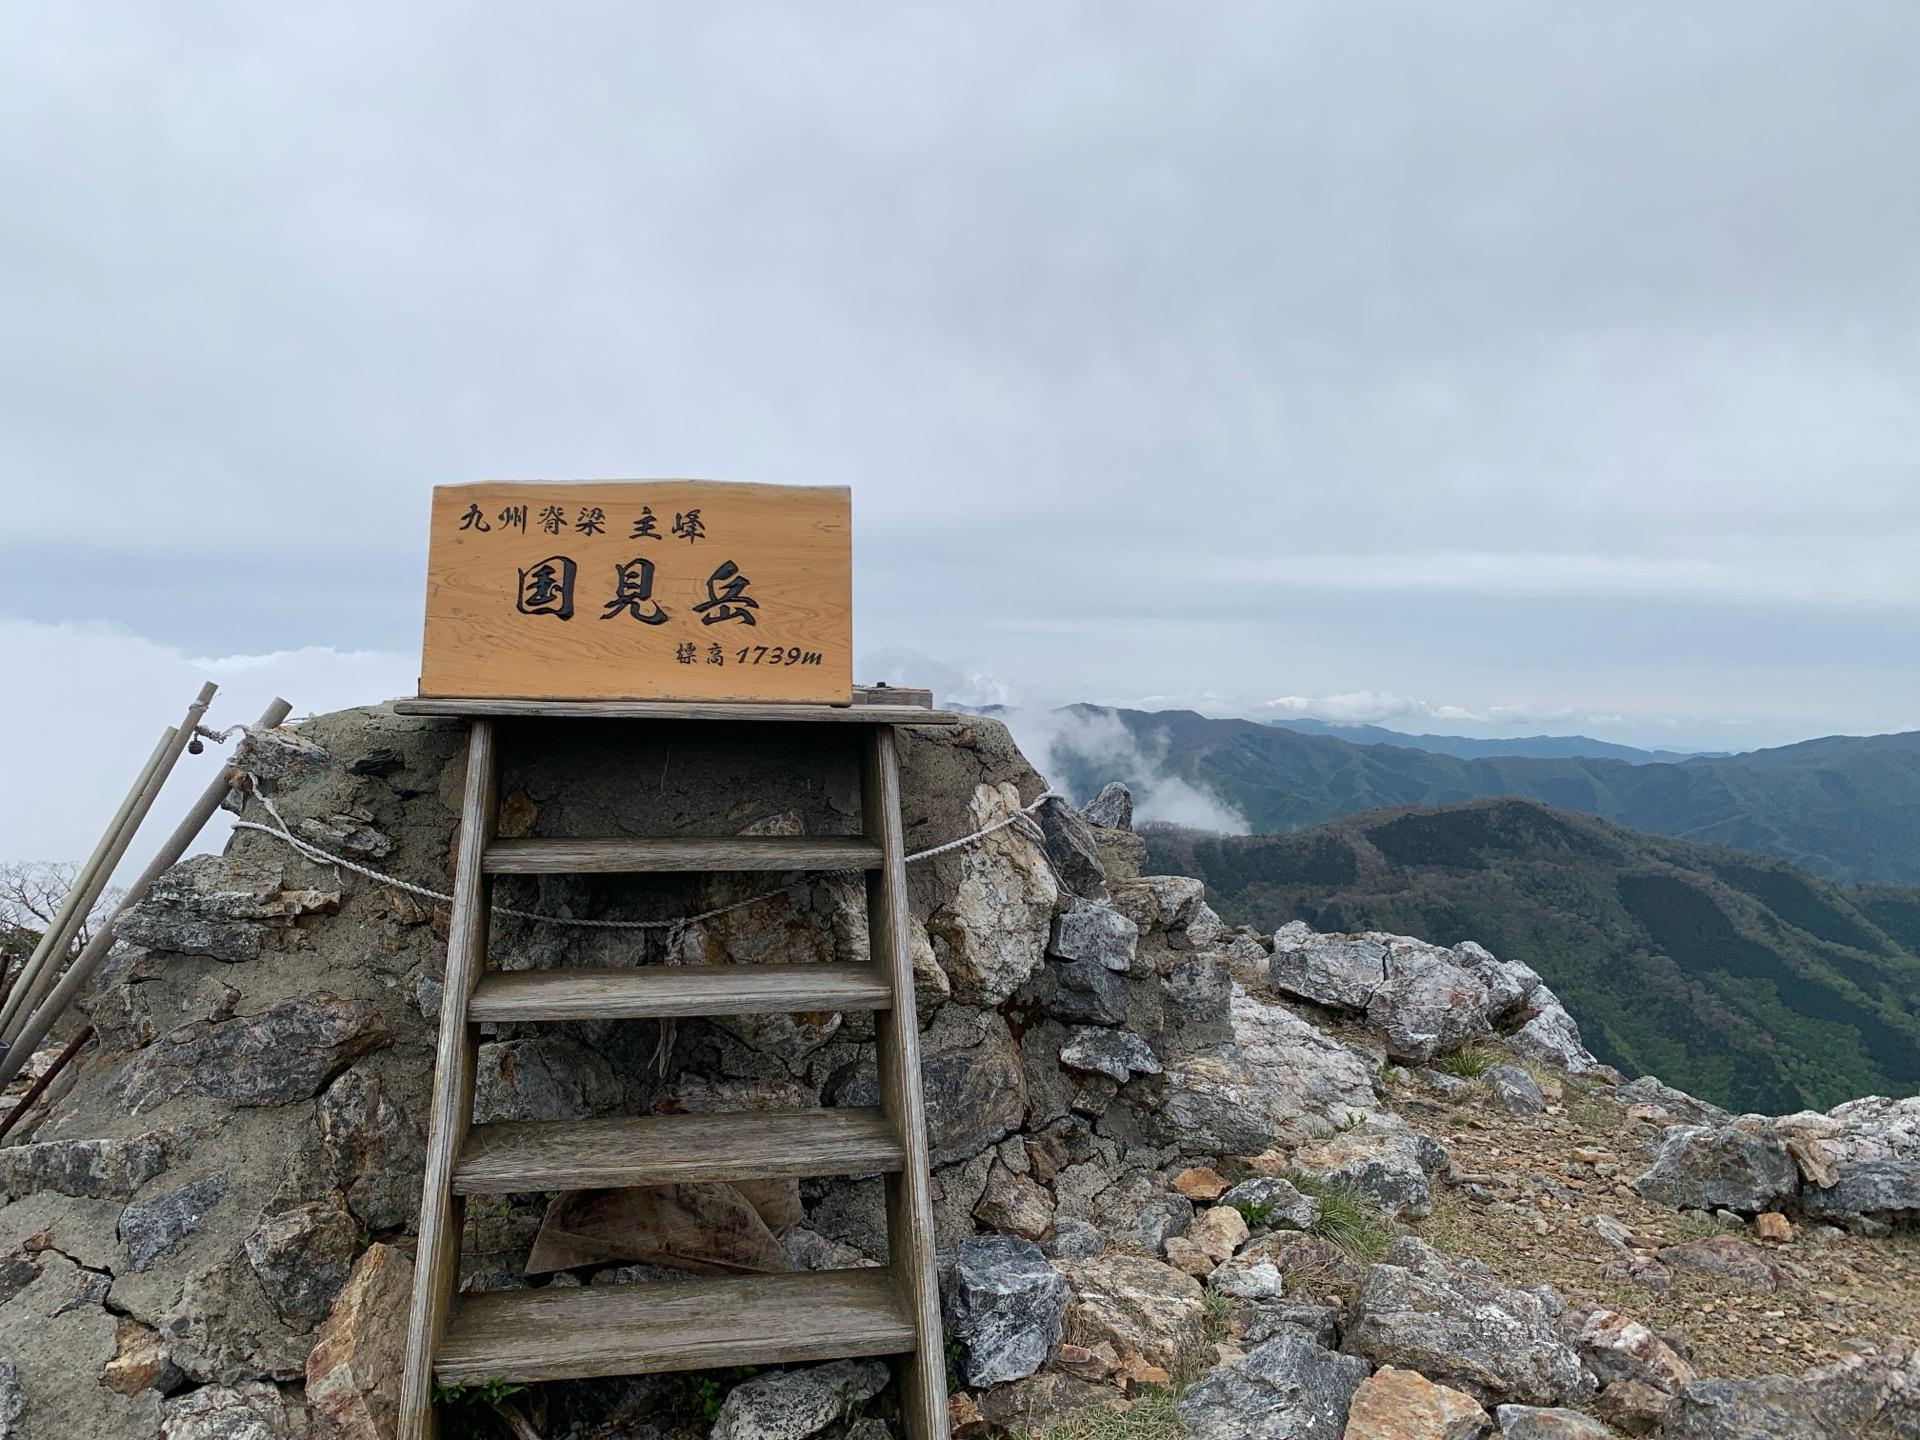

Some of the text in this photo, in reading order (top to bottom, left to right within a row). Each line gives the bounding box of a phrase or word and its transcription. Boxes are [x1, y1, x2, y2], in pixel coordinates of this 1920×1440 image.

[459, 503, 706, 545] 九州脊梁 主峰
[516, 555, 760, 627] 国見岳
